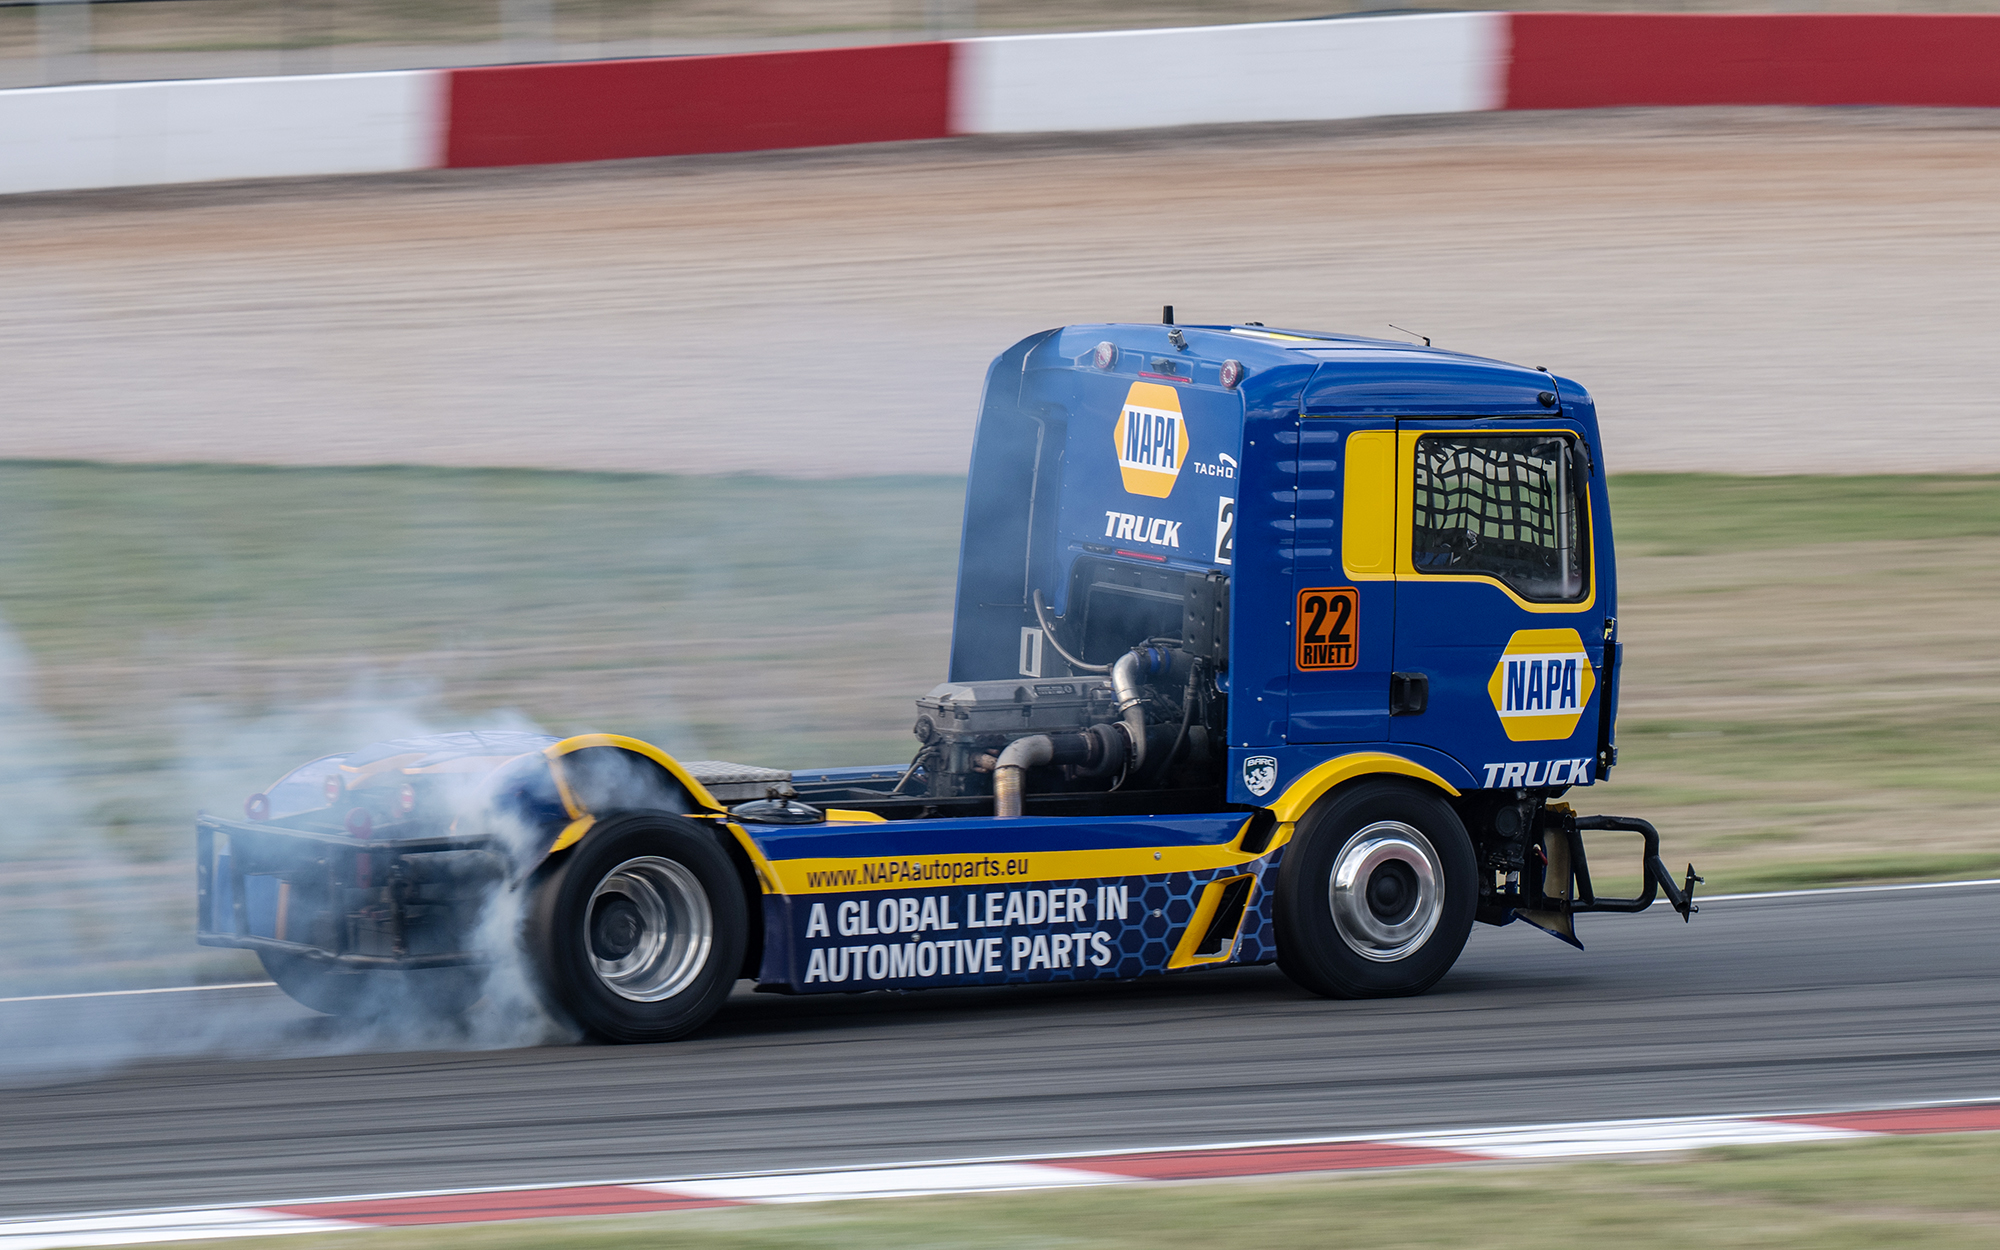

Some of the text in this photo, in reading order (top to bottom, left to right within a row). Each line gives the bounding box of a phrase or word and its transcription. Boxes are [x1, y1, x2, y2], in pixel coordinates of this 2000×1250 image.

[1126, 411, 1175, 469] NAPA
[1193, 461, 1236, 479] TACHO
[1105, 511, 1182, 548] TRUCK
[1304, 594, 1352, 643] 22
[1303, 644, 1352, 664] RIVETT
[1506, 659, 1577, 711] NAPA
[1247, 758, 1274, 767] BARC
[1483, 757, 1593, 788] TRUCK
[806, 857, 1029, 888] www.NAPAautoparts.eu
[805, 885, 1128, 938] A GLOBAL LEADER IN
[804, 931, 1112, 984] AUTOMOTIVE PARTS
